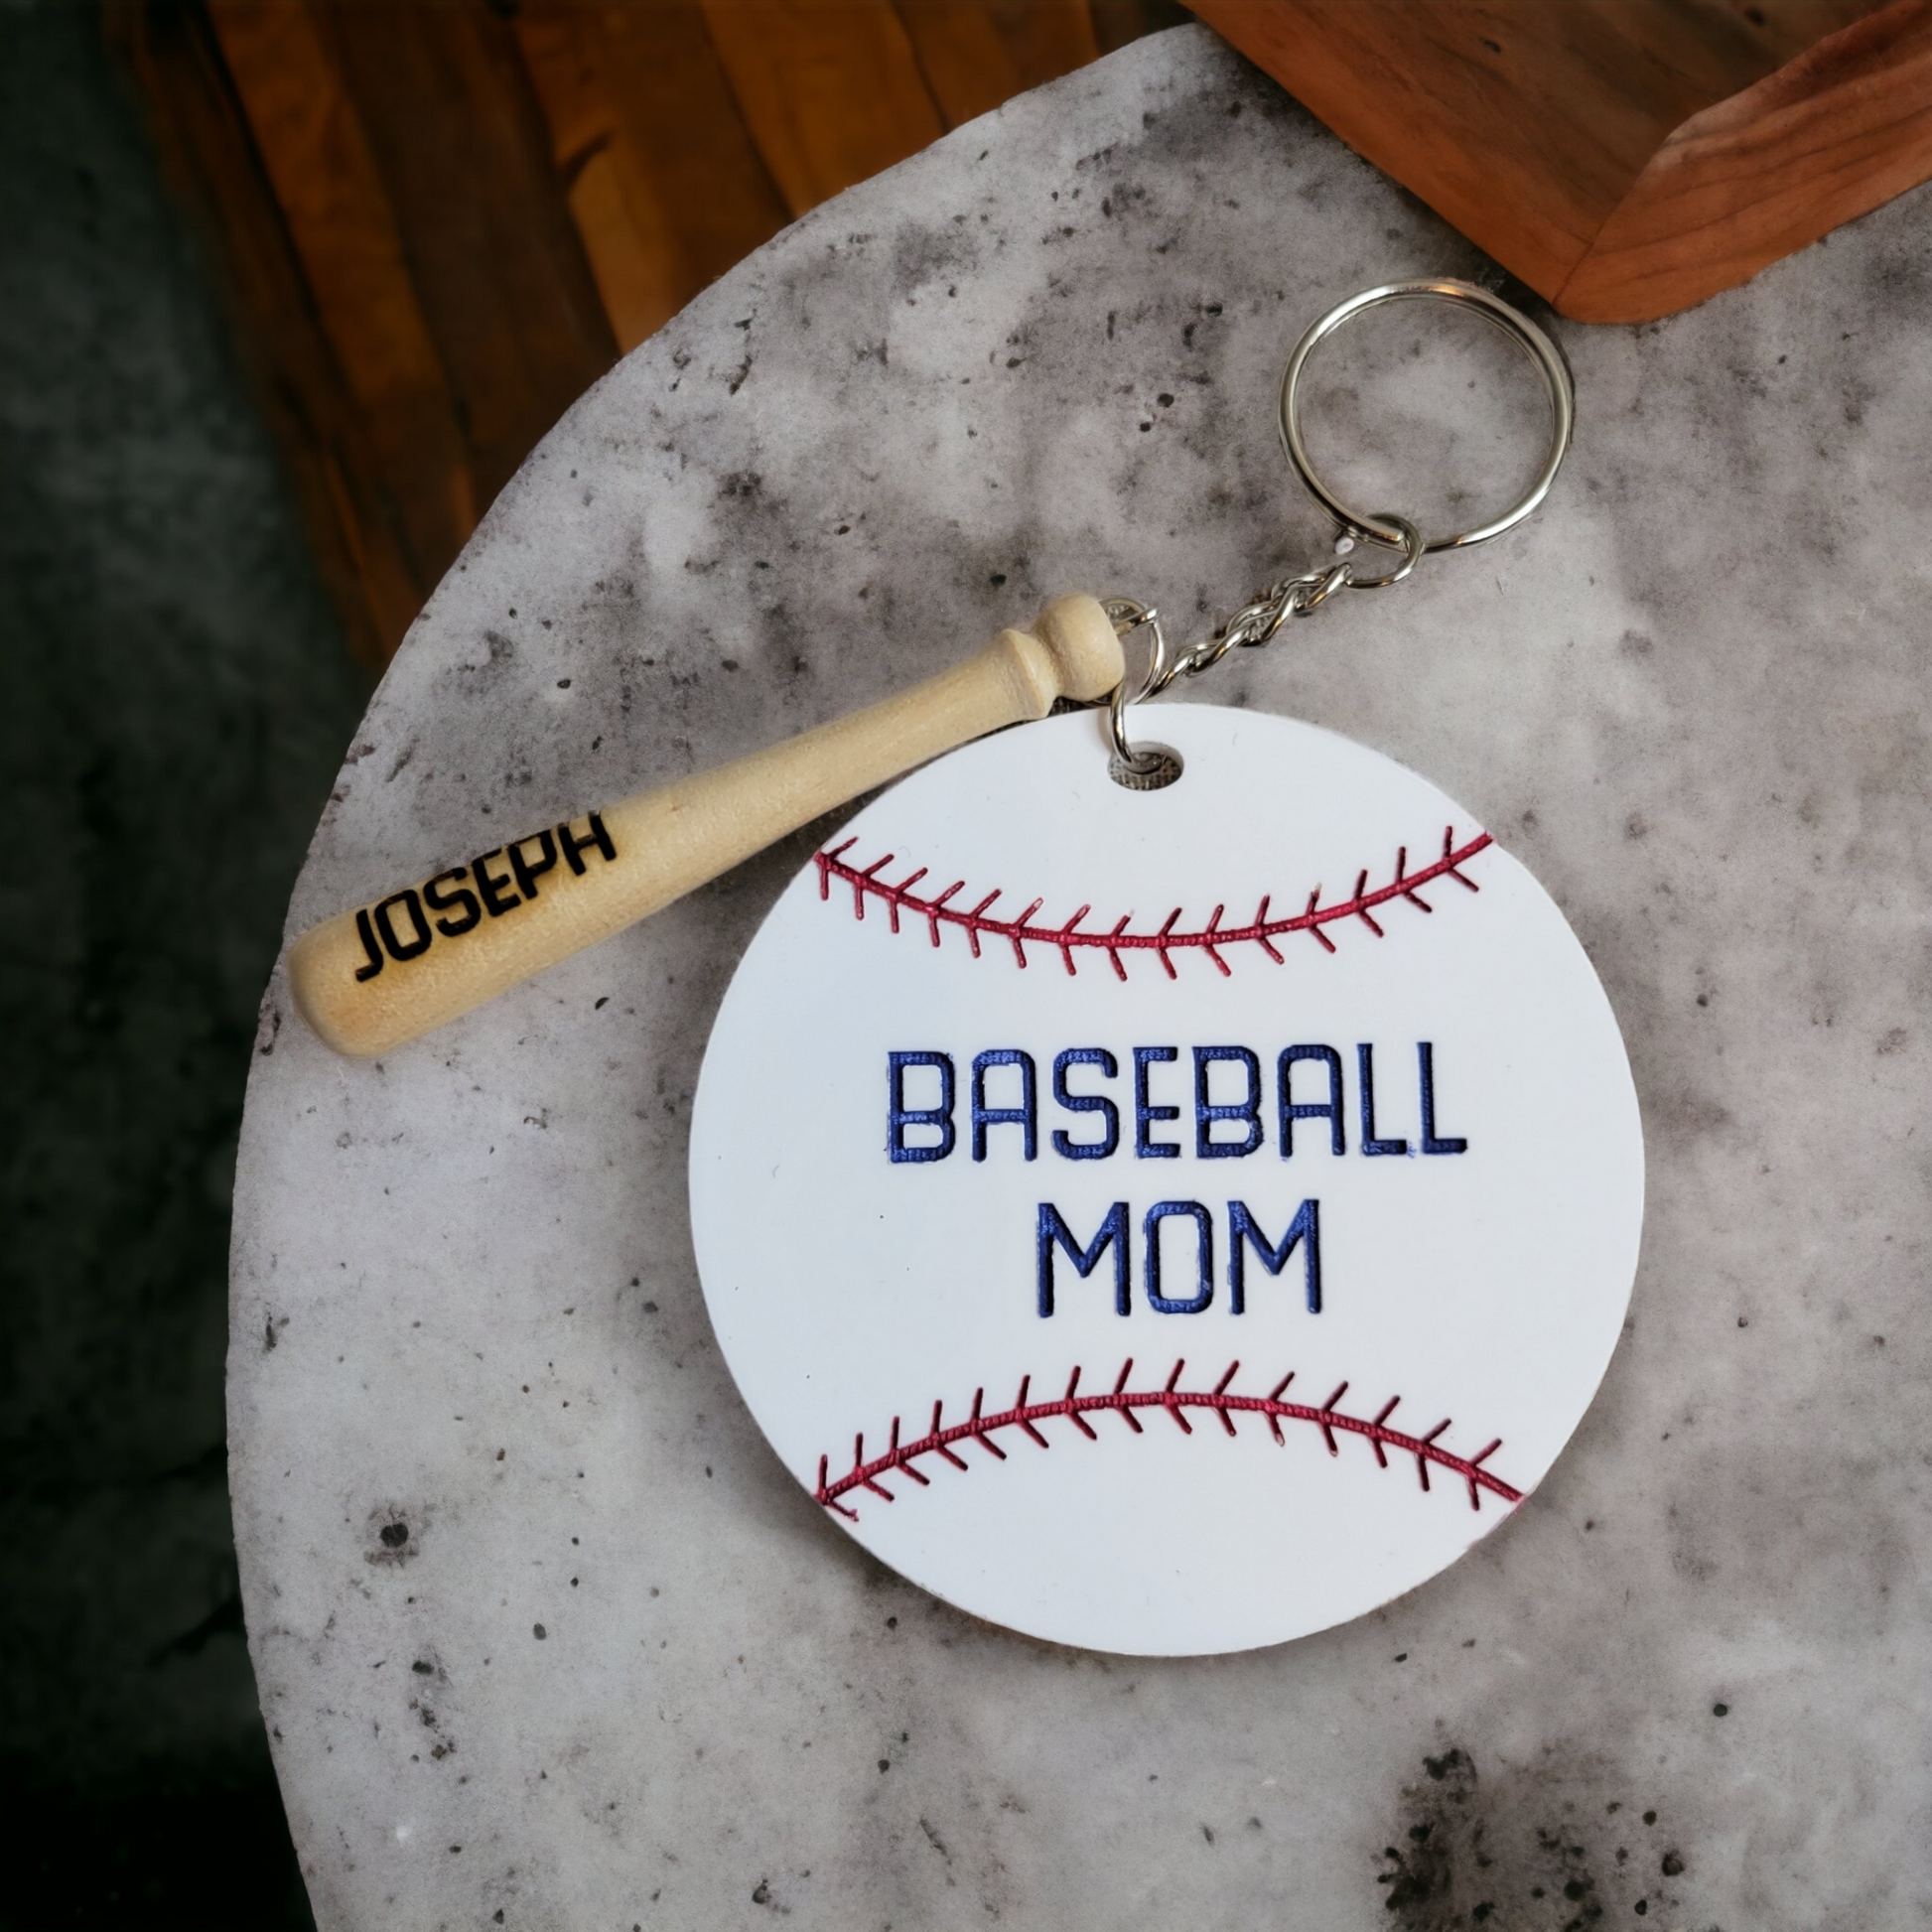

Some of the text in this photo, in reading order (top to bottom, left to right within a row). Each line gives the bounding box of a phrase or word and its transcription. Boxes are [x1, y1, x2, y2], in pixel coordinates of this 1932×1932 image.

[354, 810, 617, 982] JOSEPH
[887, 1041, 1468, 1164] BASEBALL
[1036, 1198, 1322, 1317] MOM
